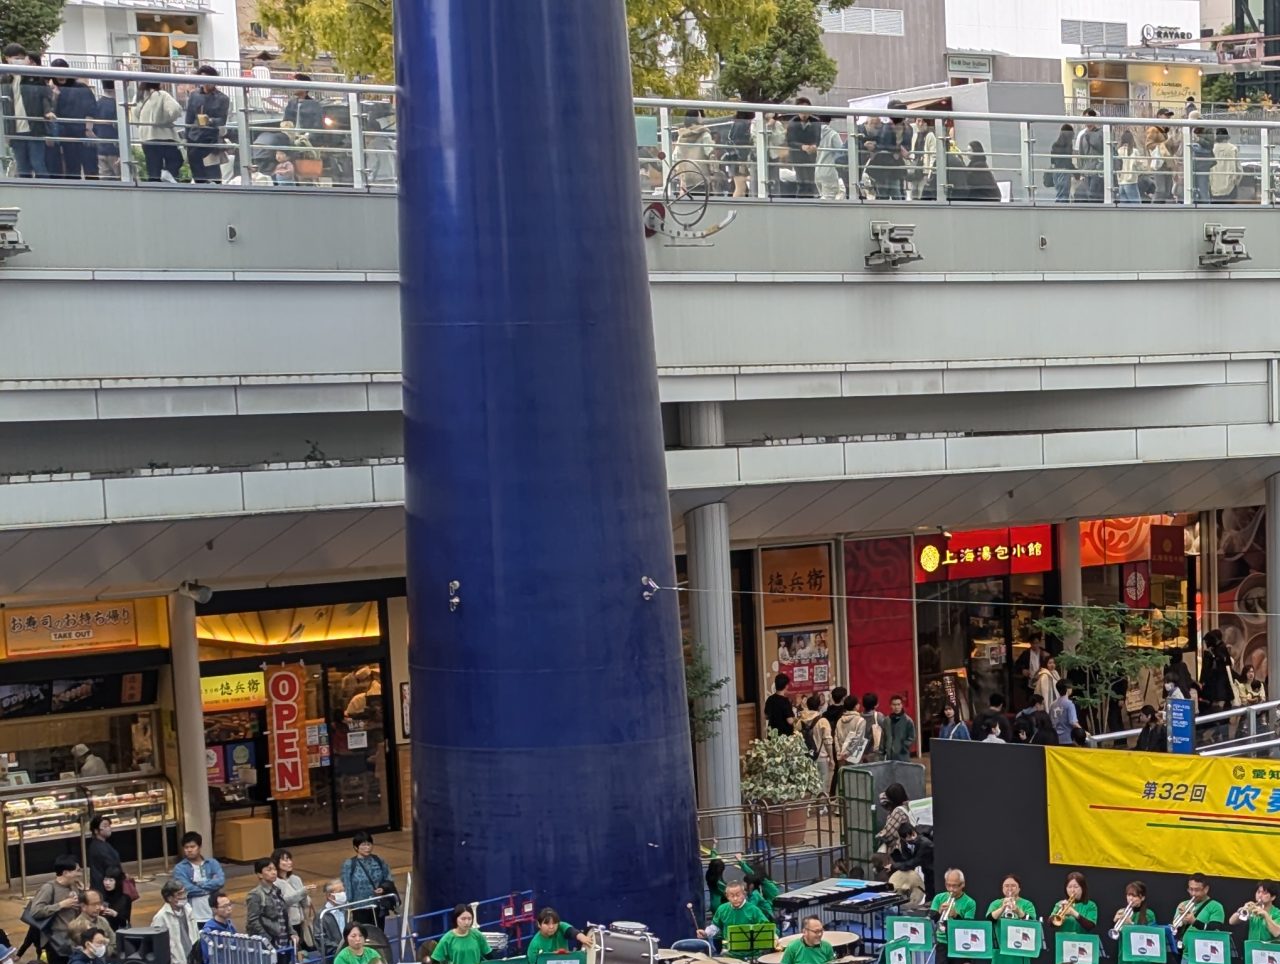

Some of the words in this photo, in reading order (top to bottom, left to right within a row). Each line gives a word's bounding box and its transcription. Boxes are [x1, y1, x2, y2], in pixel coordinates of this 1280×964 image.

[941, 541, 1043, 566] 上海湯包小館
[10, 607, 130, 633] お寿司のお持ち帰り
[53, 631, 73, 640] TAKE
[75, 630, 91, 638] OUT
[269, 671, 302, 791] OPEN
[1142, 781, 1207, 803] 第32回
